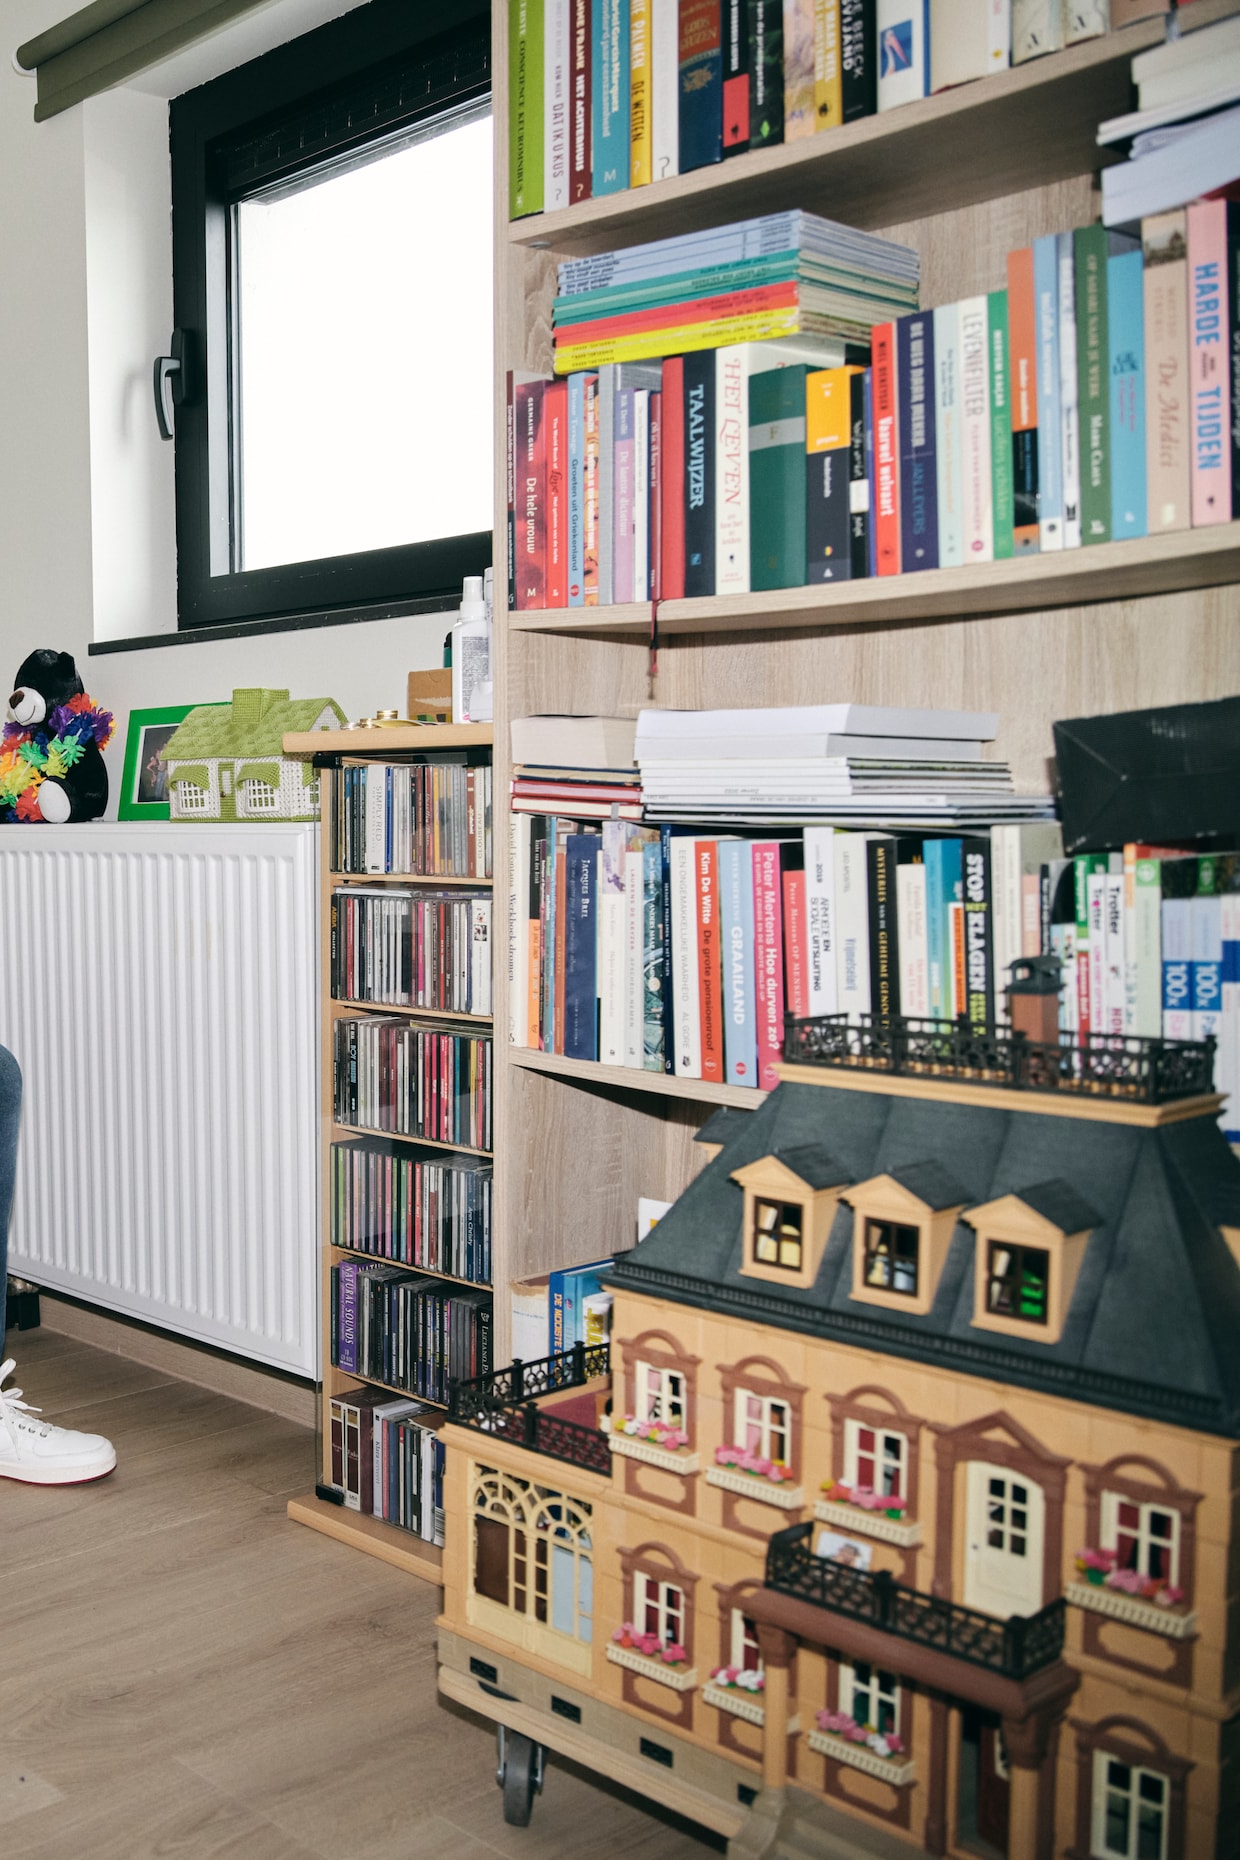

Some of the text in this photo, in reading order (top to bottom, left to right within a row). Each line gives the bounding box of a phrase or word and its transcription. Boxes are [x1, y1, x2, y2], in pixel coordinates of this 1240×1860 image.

[630, 20, 646, 70] PALMEN
[553, 103, 563, 124] DAT
[575, 28, 586, 172] FRANK HET ACHTERHUIS
[631, 81, 645, 144] DE WETTEN
[517, 111, 525, 192] KEUROMNIBUS
[553, 126, 563, 140] IK
[553, 155, 563, 178] KUS
[604, 169, 616, 183] M
[724, 357, 742, 414] HET
[1195, 262, 1222, 471] HARDE TIJDEN
[688, 384, 705, 510] TAALWIJZER
[719, 417, 741, 506] LEVEN
[823, 457, 832, 498] Nederlands
[879, 416, 895, 517] Vaarwel welvaart
[526, 478, 537, 554] De hele vrouw
[571, 459, 579, 571] Groeten uit Griekenland
[527, 588, 536, 598] M
[509, 823, 518, 851] David
[580, 859, 590, 919] JACQUES BREL
[700, 852, 712, 924] Kim De Witte
[763, 851, 776, 945] Peter Mertens
[816, 863, 824, 884] 2019
[965, 853, 985, 902] STOP
[509, 894, 517, 981] Werkboek dromen
[678, 849, 690, 1002] EEN ONGEMAKKELIJKE WAARHEID
[789, 882, 800, 961] Peter Mertens OP
[877, 847, 889, 978] MYSTERIES GEHEIME
[1092, 888, 1102, 931] Trotter
[1109, 886, 1120, 935] Trotter
[731, 925, 745, 1025] GRAAILAND
[811, 935, 821, 991] UITSLUITING
[823, 939, 831, 952] EN
[967, 911, 987, 992] KLAGEN
[702, 929, 714, 1051] De grote pensioenroof
[766, 947, 780, 1051] Hoe durven ze?
[1166, 963, 1188, 1008] 100x
[1196, 963, 1218, 1008] 100x
[682, 1011, 691, 1049] AL GORE
[345, 1266, 354, 1345] NATURAL SOUNDS
[554, 1293, 563, 1347] DE MOOISTE
